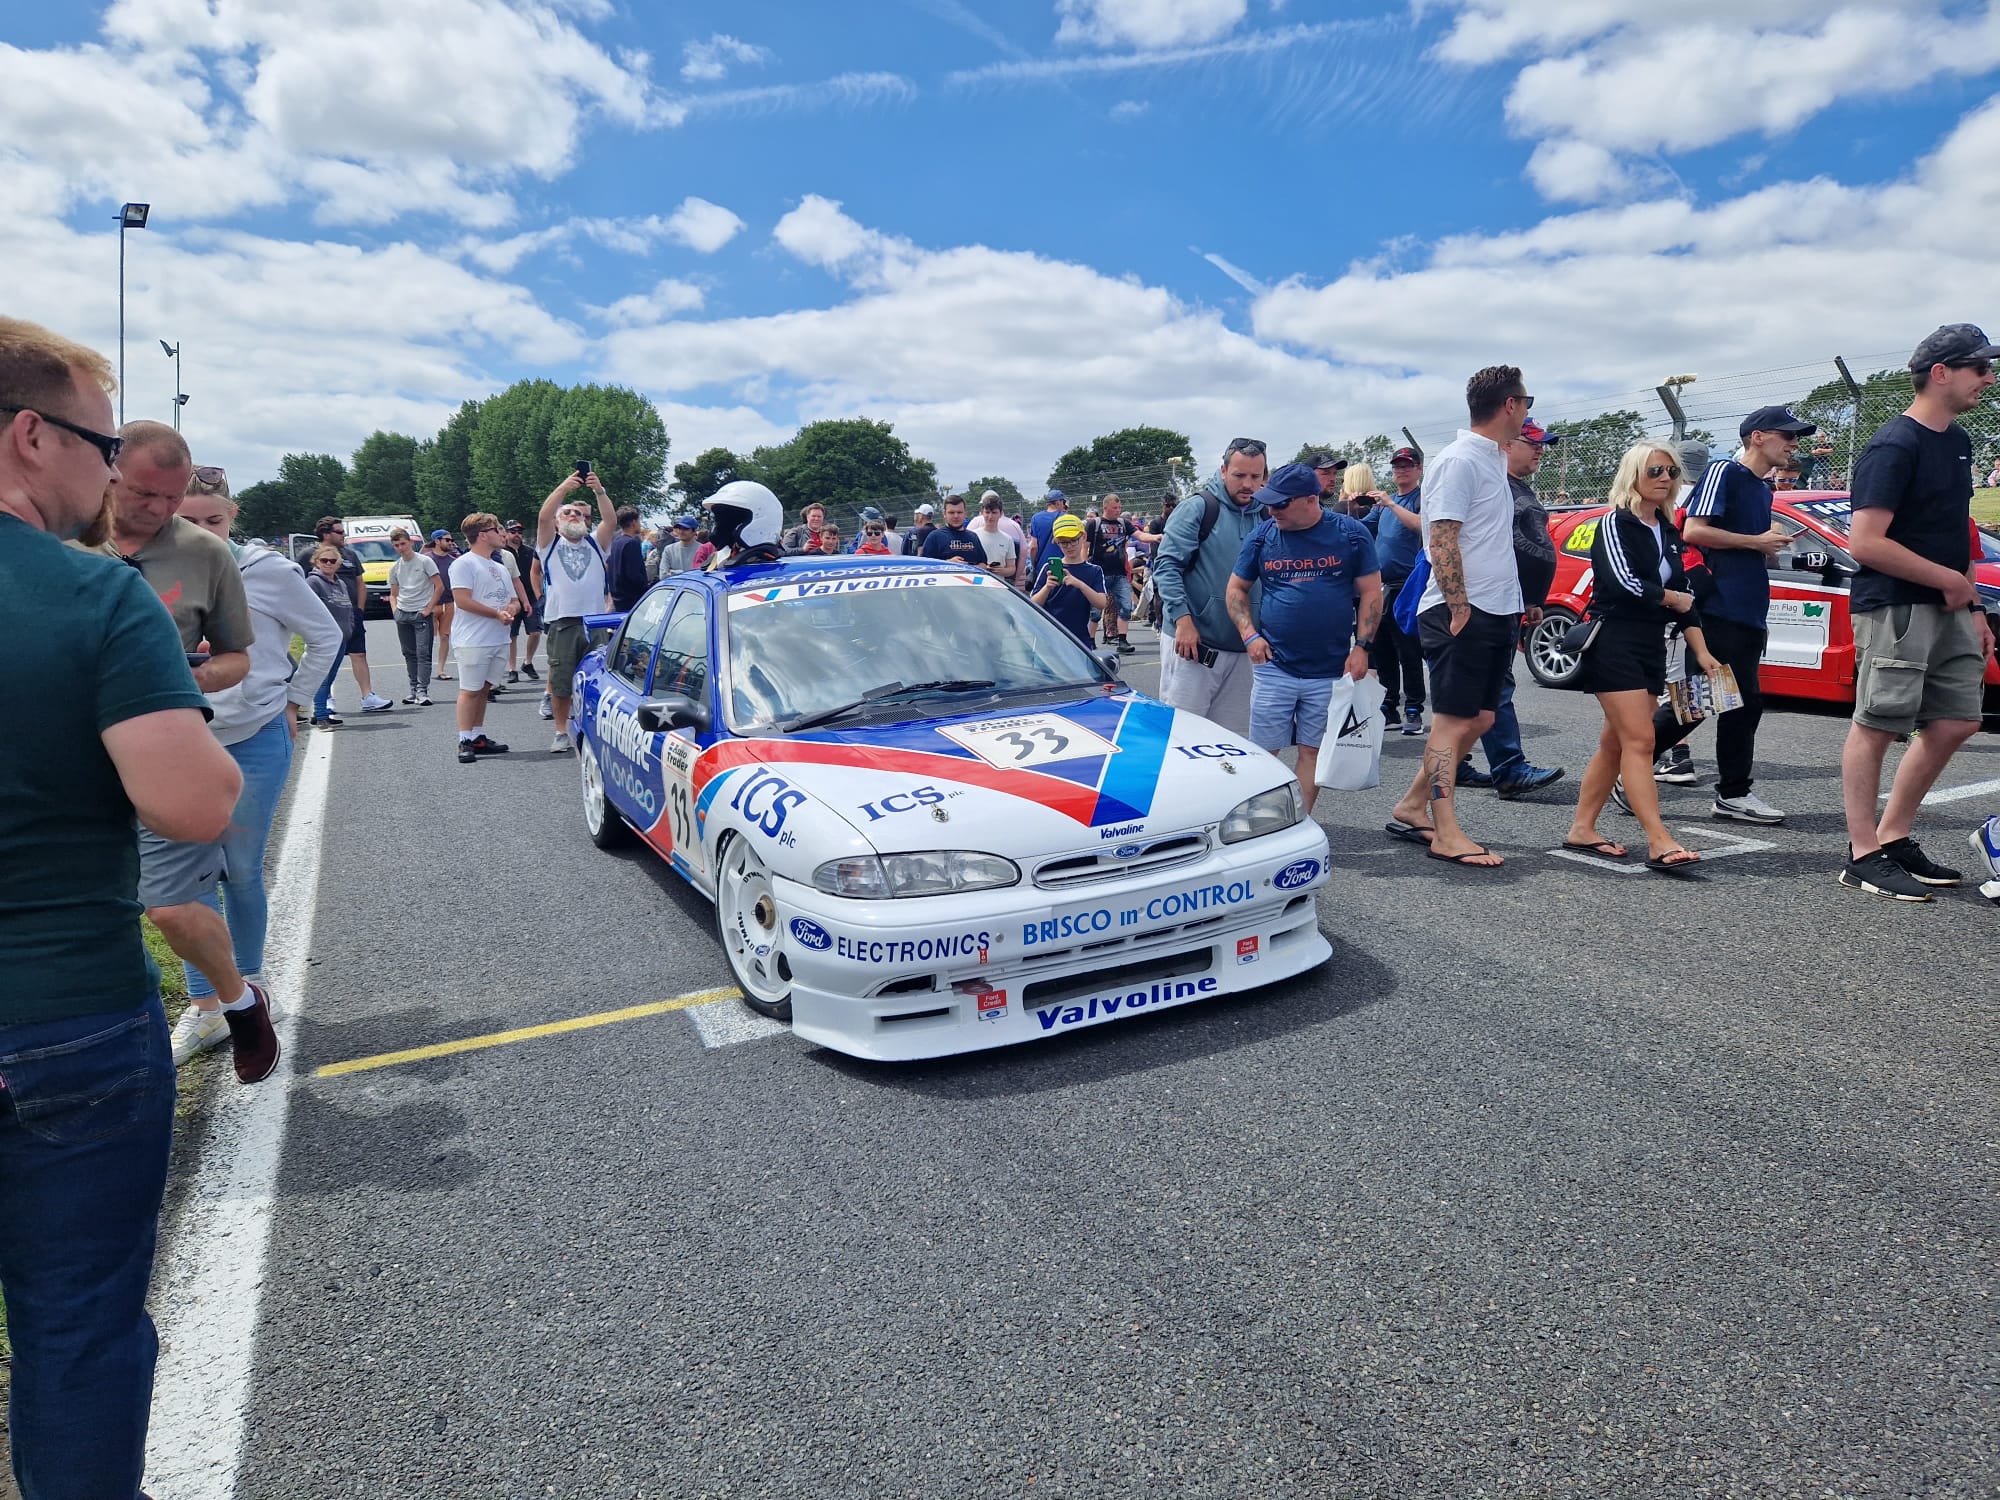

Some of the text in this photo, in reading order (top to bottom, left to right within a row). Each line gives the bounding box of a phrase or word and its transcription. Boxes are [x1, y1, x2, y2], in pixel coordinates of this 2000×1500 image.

[354, 525, 391, 534] MSV
[1264, 555, 1342, 570] MOTOR OIL
[798, 576, 937, 597] Valvoline
[1782, 604, 1797, 614] Flag
[995, 727, 1069, 760] 33
[1171, 743, 1248, 760] ICS
[666, 752, 689, 775] Trader
[730, 767, 808, 849] ICS plc
[857, 785, 945, 822] ICS
[1101, 824, 1145, 840] Valvoline
[1281, 863, 1315, 888] Ford
[1023, 879, 1255, 946] BRISCO in CONTROL
[795, 919, 825, 949] Ford
[837, 931, 990, 963] ELECTRONICS
[983, 999, 1002, 1007] Credit
[1036, 977, 1218, 1031] Valvoline
